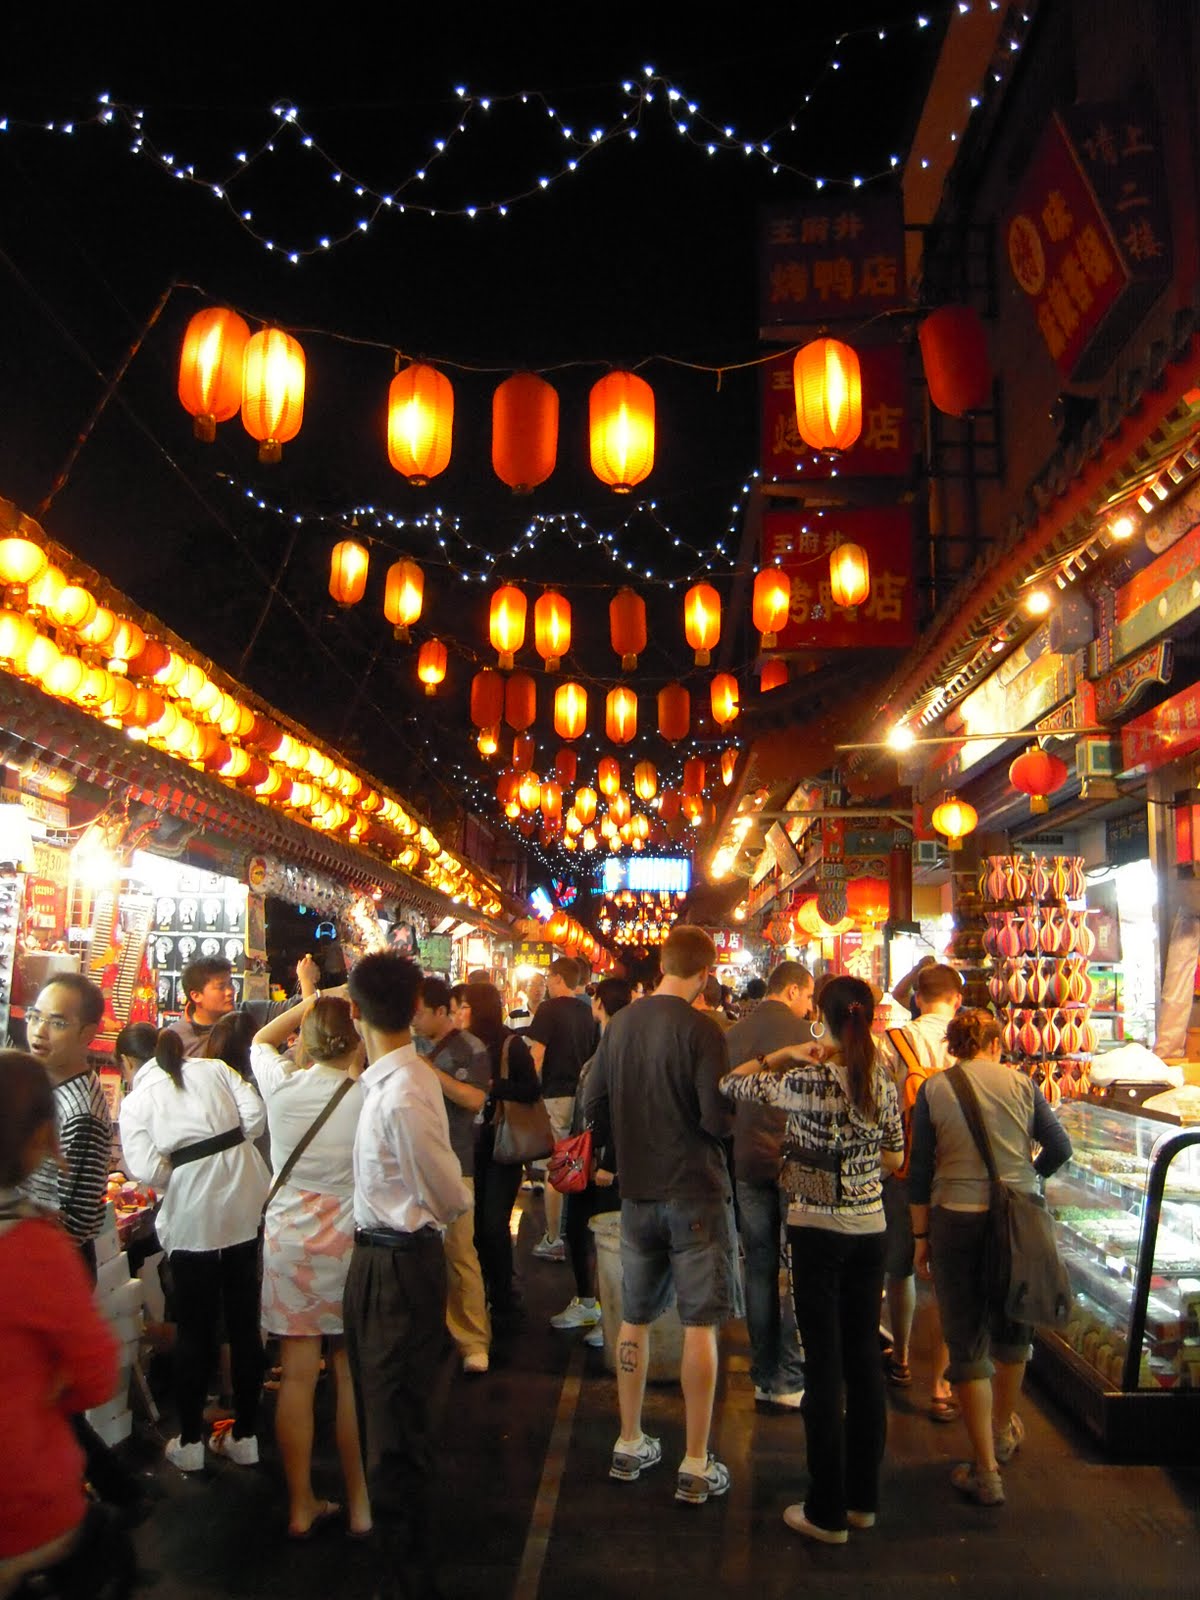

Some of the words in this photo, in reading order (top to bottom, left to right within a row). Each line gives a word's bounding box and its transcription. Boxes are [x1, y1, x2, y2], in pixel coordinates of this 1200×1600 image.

[768, 212, 863, 244] 王府井
[770, 257, 897, 303] 烤鸭店
[772, 402, 904, 455] 烤店
